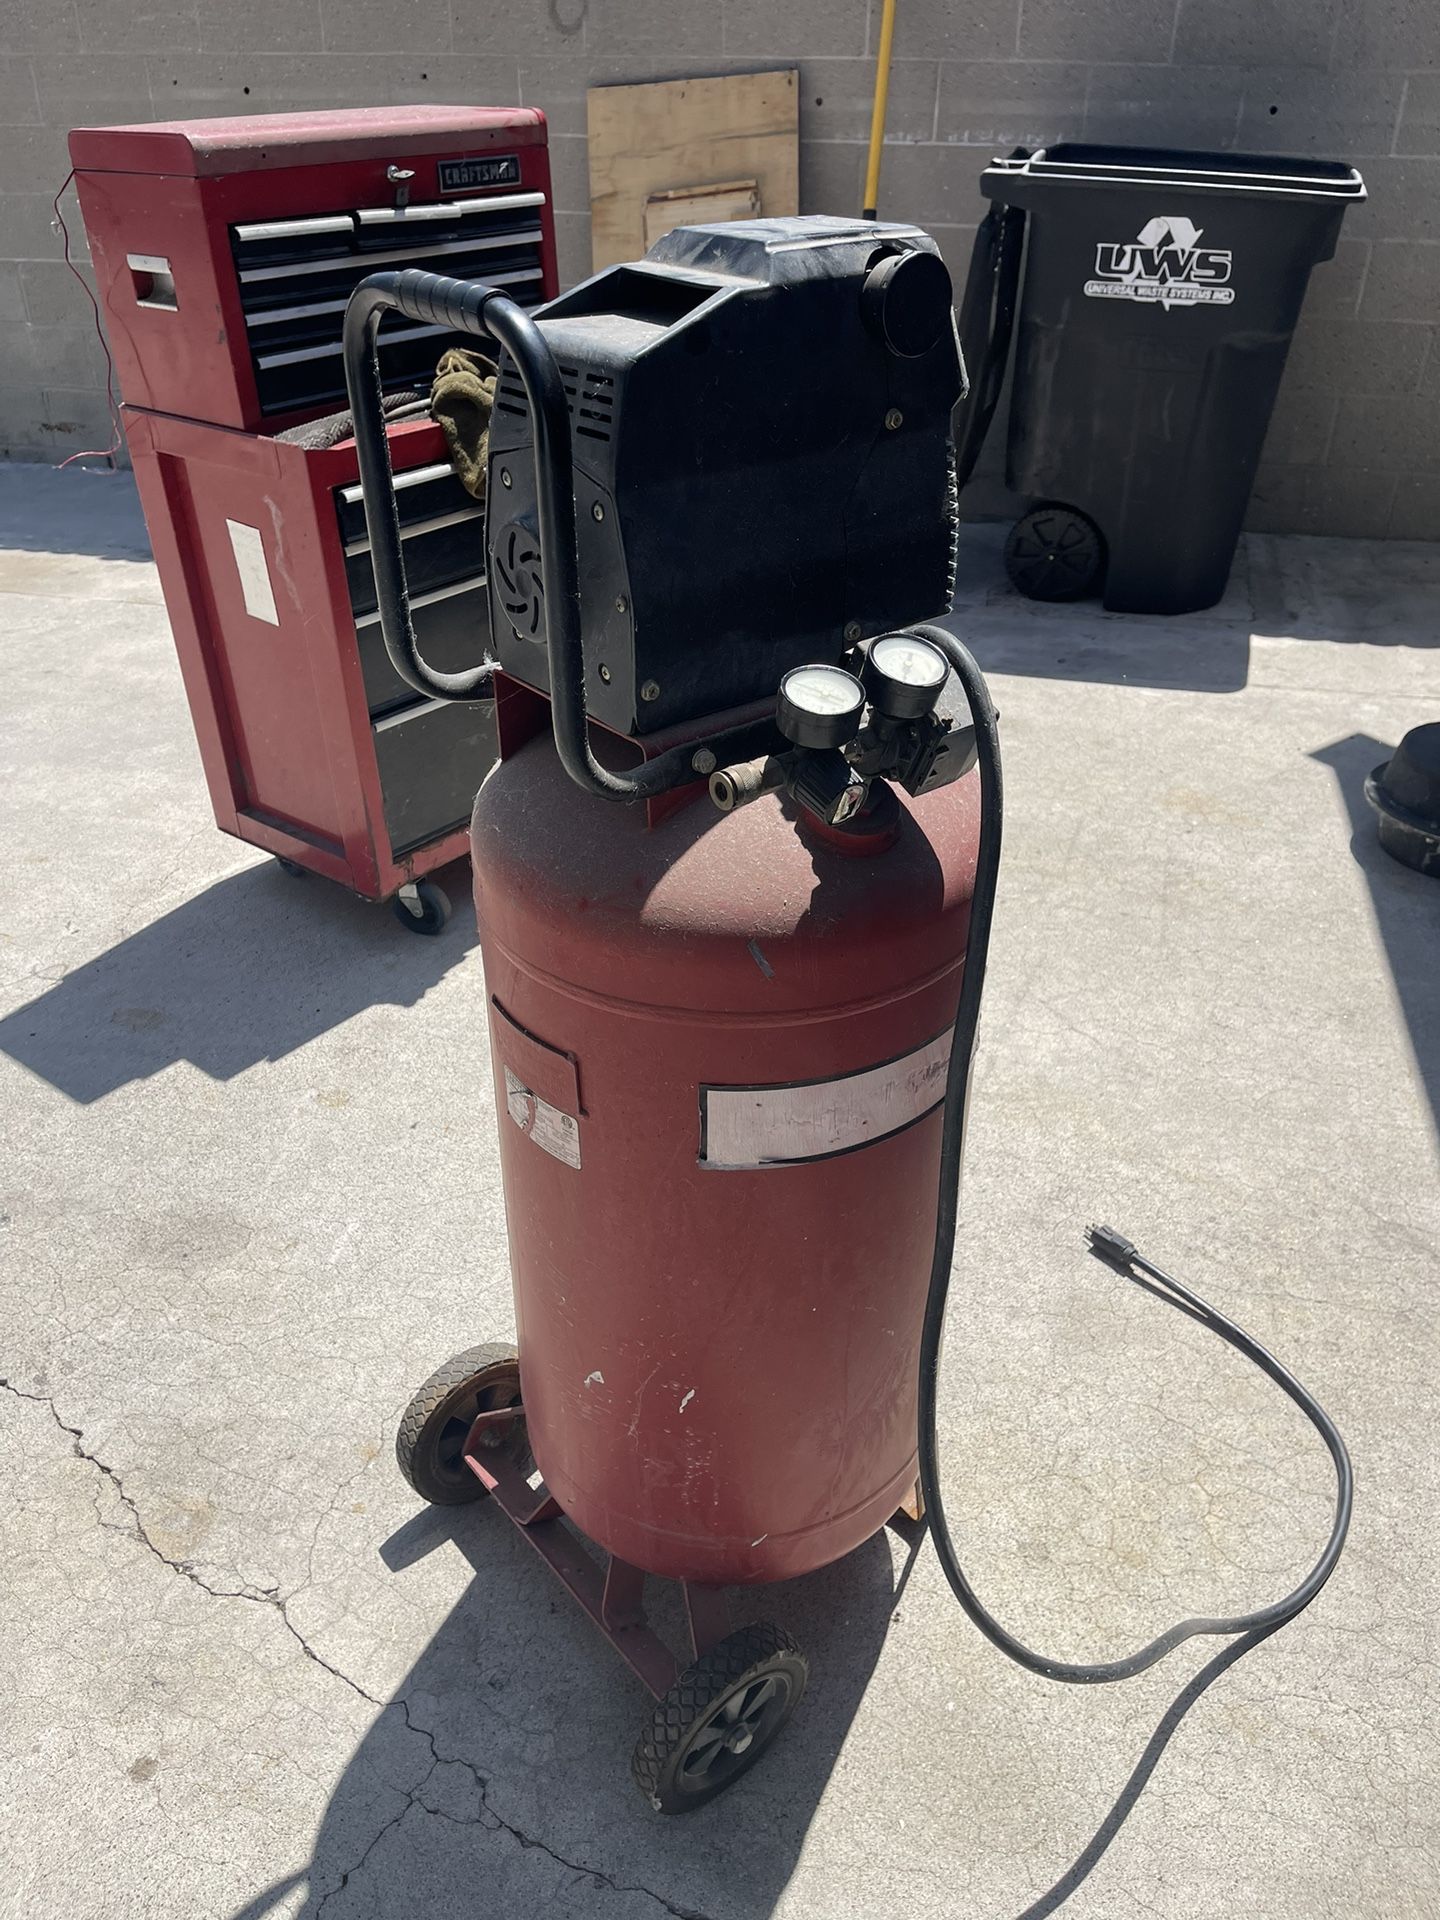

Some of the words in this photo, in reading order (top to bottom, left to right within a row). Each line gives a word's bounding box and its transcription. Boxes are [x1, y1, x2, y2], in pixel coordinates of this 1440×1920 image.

[445, 161, 516, 184] CRAFTSMAN
[1095, 243, 1232, 283] UWS
[1087, 283, 1135, 296] UNIVERSAL
[1137, 285, 1169, 298] WASTE
[1169, 287, 1212, 300] SYSTEMS
